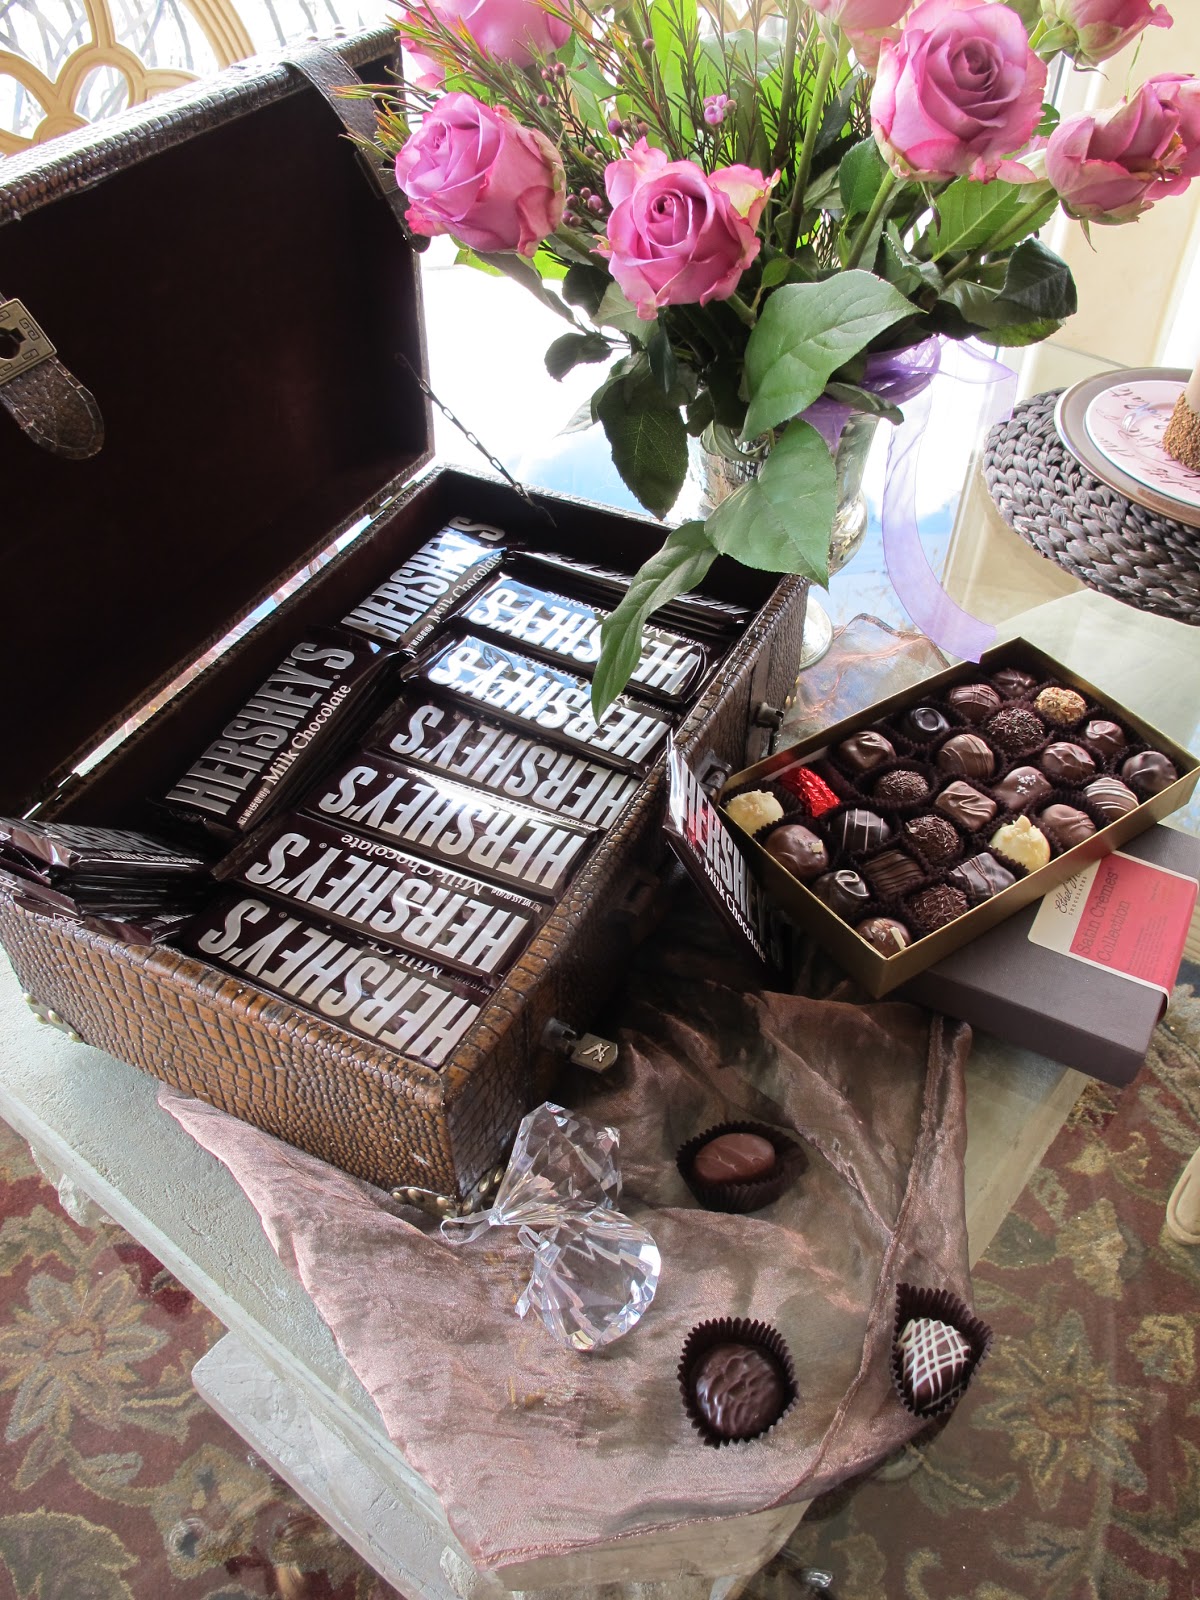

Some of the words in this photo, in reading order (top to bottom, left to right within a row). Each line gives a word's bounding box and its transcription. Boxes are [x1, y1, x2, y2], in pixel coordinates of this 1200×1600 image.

[427, 597, 455, 623] Milk
[453, 552, 502, 597] Chocolate
[544, 590, 613, 620] hocolate
[470, 587, 700, 694] HESHEY'S
[166, 642, 355, 816] HERSHEY'S
[262, 750, 299, 785] Milk
[291, 685, 351, 749] Chocolate
[390, 704, 640, 829] HERSHEY'S
[319, 765, 588, 889] HERSHEY'S
[341, 834, 435, 877] Chocolate
[245, 833, 529, 973] HERSHEY'S
[436, 872, 484, 896] Milk
[704, 858, 726, 901] Milk
[1055, 882, 1073, 914] Ethel
[1076, 920, 1100, 954] Satin
[1090, 871, 1119, 918] Crèmes
[1097, 900, 1131, 962] Collection
[198, 899, 481, 1064] HERSHEY'S
